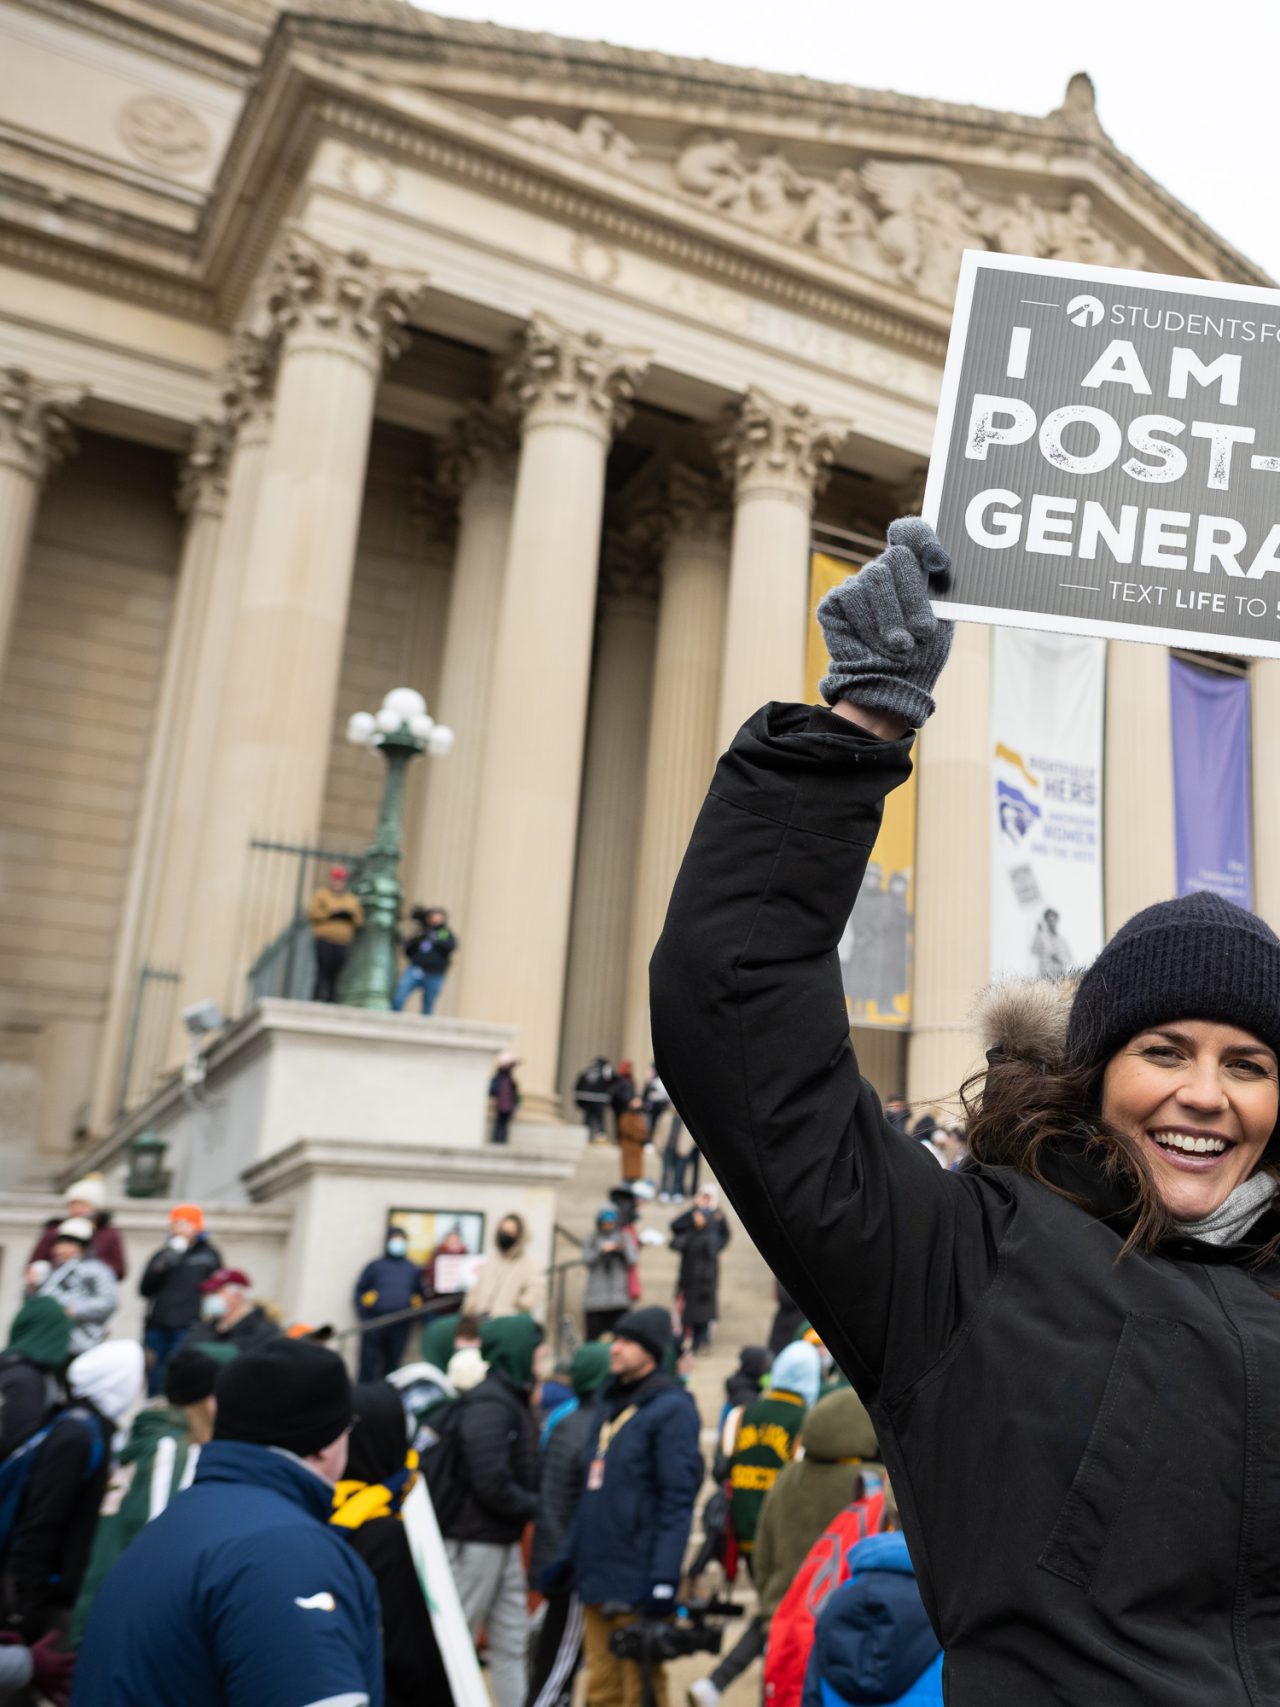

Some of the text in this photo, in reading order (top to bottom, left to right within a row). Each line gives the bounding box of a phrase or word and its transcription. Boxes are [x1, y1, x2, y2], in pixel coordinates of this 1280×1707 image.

[1006, 326, 1031, 379] I
[1080, 339, 1242, 406] AM
[1109, 581, 1167, 606] TEXT
[1175, 589, 1226, 613] LIFE
[1235, 597, 1267, 617] TO
